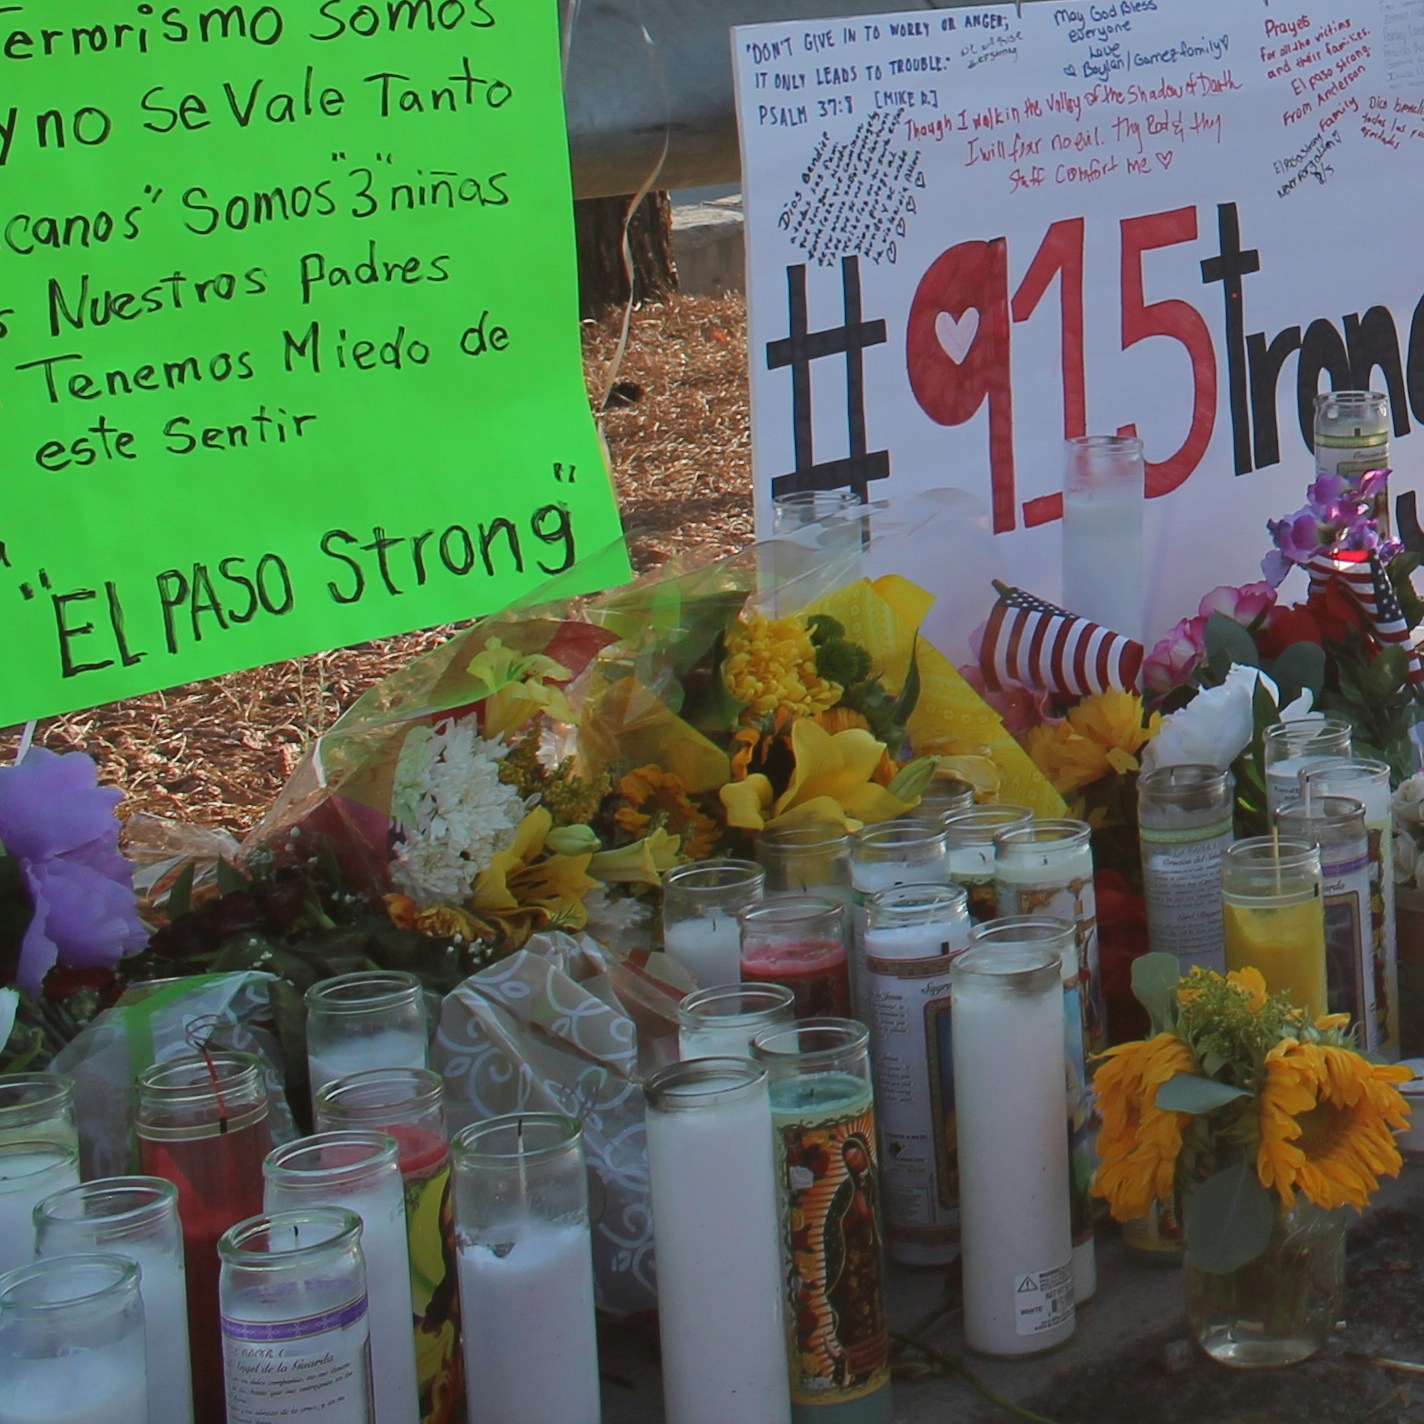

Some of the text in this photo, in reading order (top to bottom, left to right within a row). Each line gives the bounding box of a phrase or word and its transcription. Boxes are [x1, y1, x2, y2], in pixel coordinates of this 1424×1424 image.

[1088, 3, 1119, 23] God
[804, 30, 836, 54] GIVE
[843, 27, 857, 43] IN
[864, 25, 881, 41] TO
[889, 21, 931, 37] WORRY
[941, 17, 957, 30] OR
[223, 64, 346, 128] Vale
[363, 56, 513, 119] Tanto
[755, 71, 769, 89] IT
[774, 74, 806, 92] ONLY
[816, 65, 858, 87] LEADS
[866, 65, 882, 81] TO
[1291, 77, 1308, 96] El
[758, 103, 808, 126] PSALM
[817, 94, 854, 119] 37:8
[903, 113, 953, 144] Though
[48, 268, 267, 337] Nuestros
[15, 310, 511, 404] Tenemos Miedo de
[35, 416, 137, 472] este
[156, 552, 294, 655] PASO
